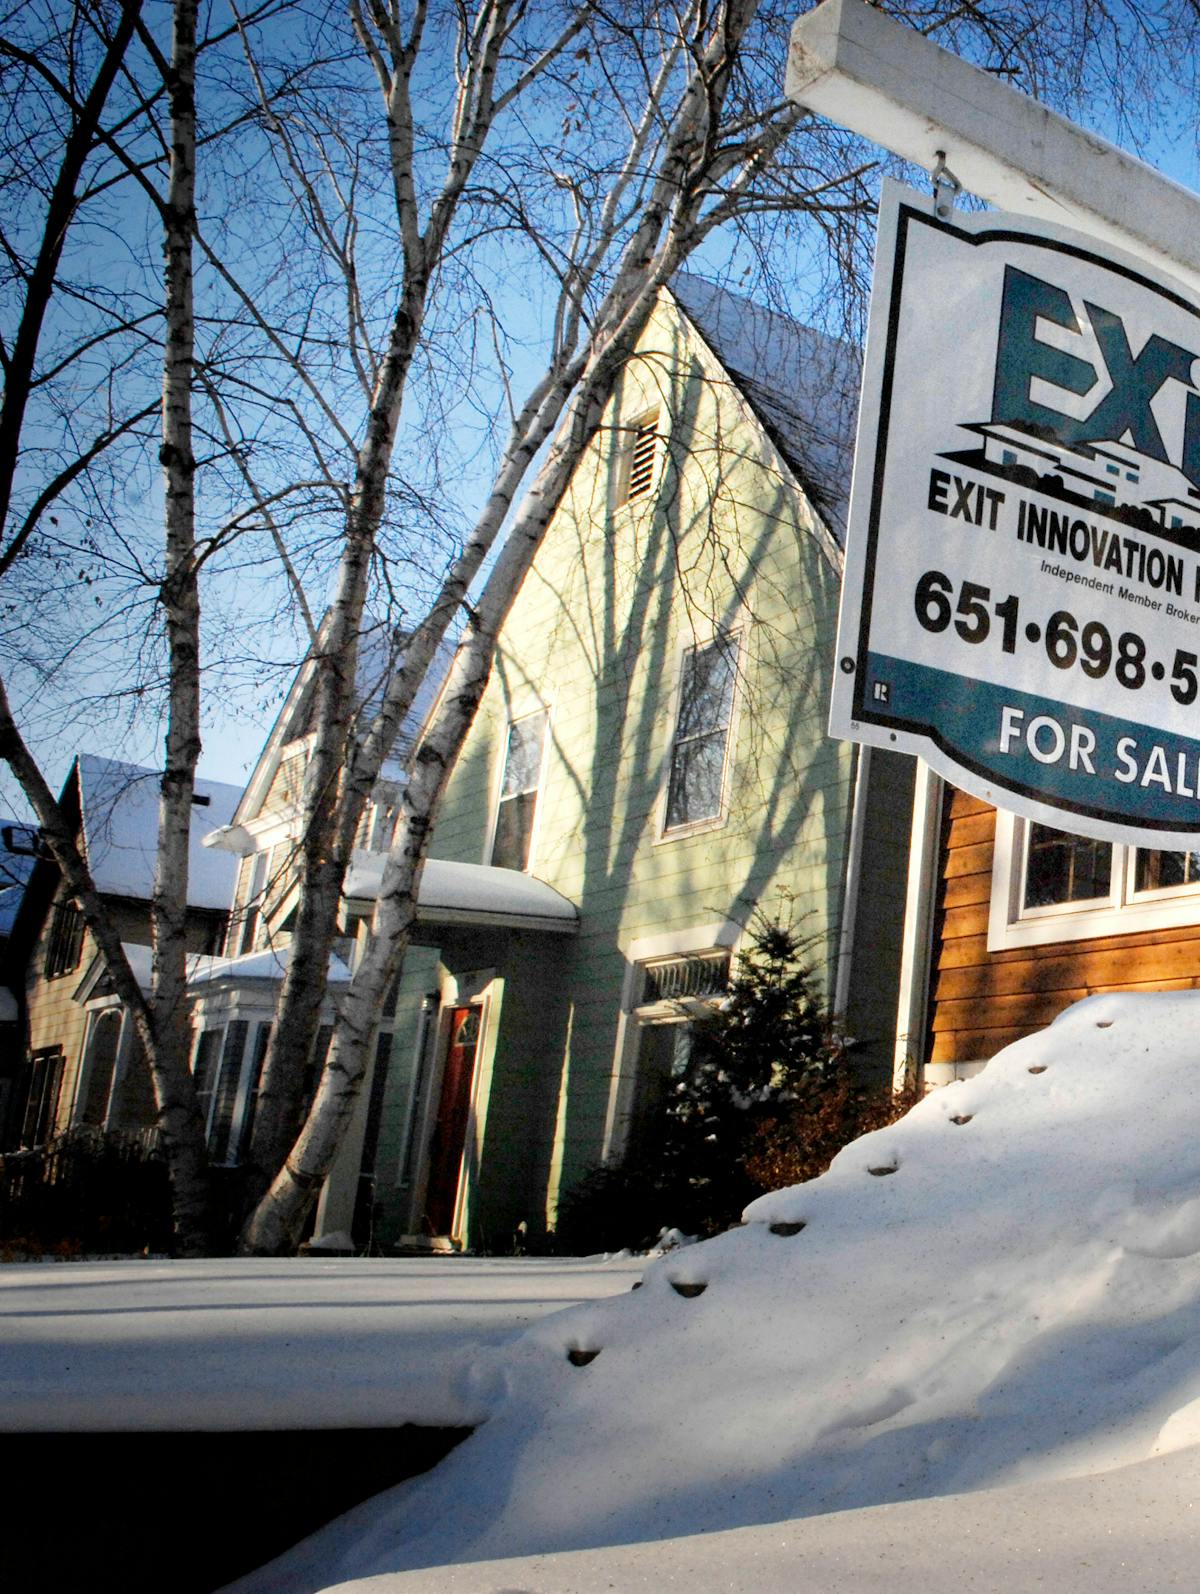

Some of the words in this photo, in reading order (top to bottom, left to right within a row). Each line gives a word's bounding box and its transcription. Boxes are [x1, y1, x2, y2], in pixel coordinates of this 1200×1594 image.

[928, 468, 1005, 531] EXIT
[1017, 500, 1183, 596] INNOVATION
[1040, 560, 1114, 595] Independent
[1118, 587, 1162, 612] Member
[1166, 603, 1200, 625] Broker
[1000, 706, 1096, 774] FOR
